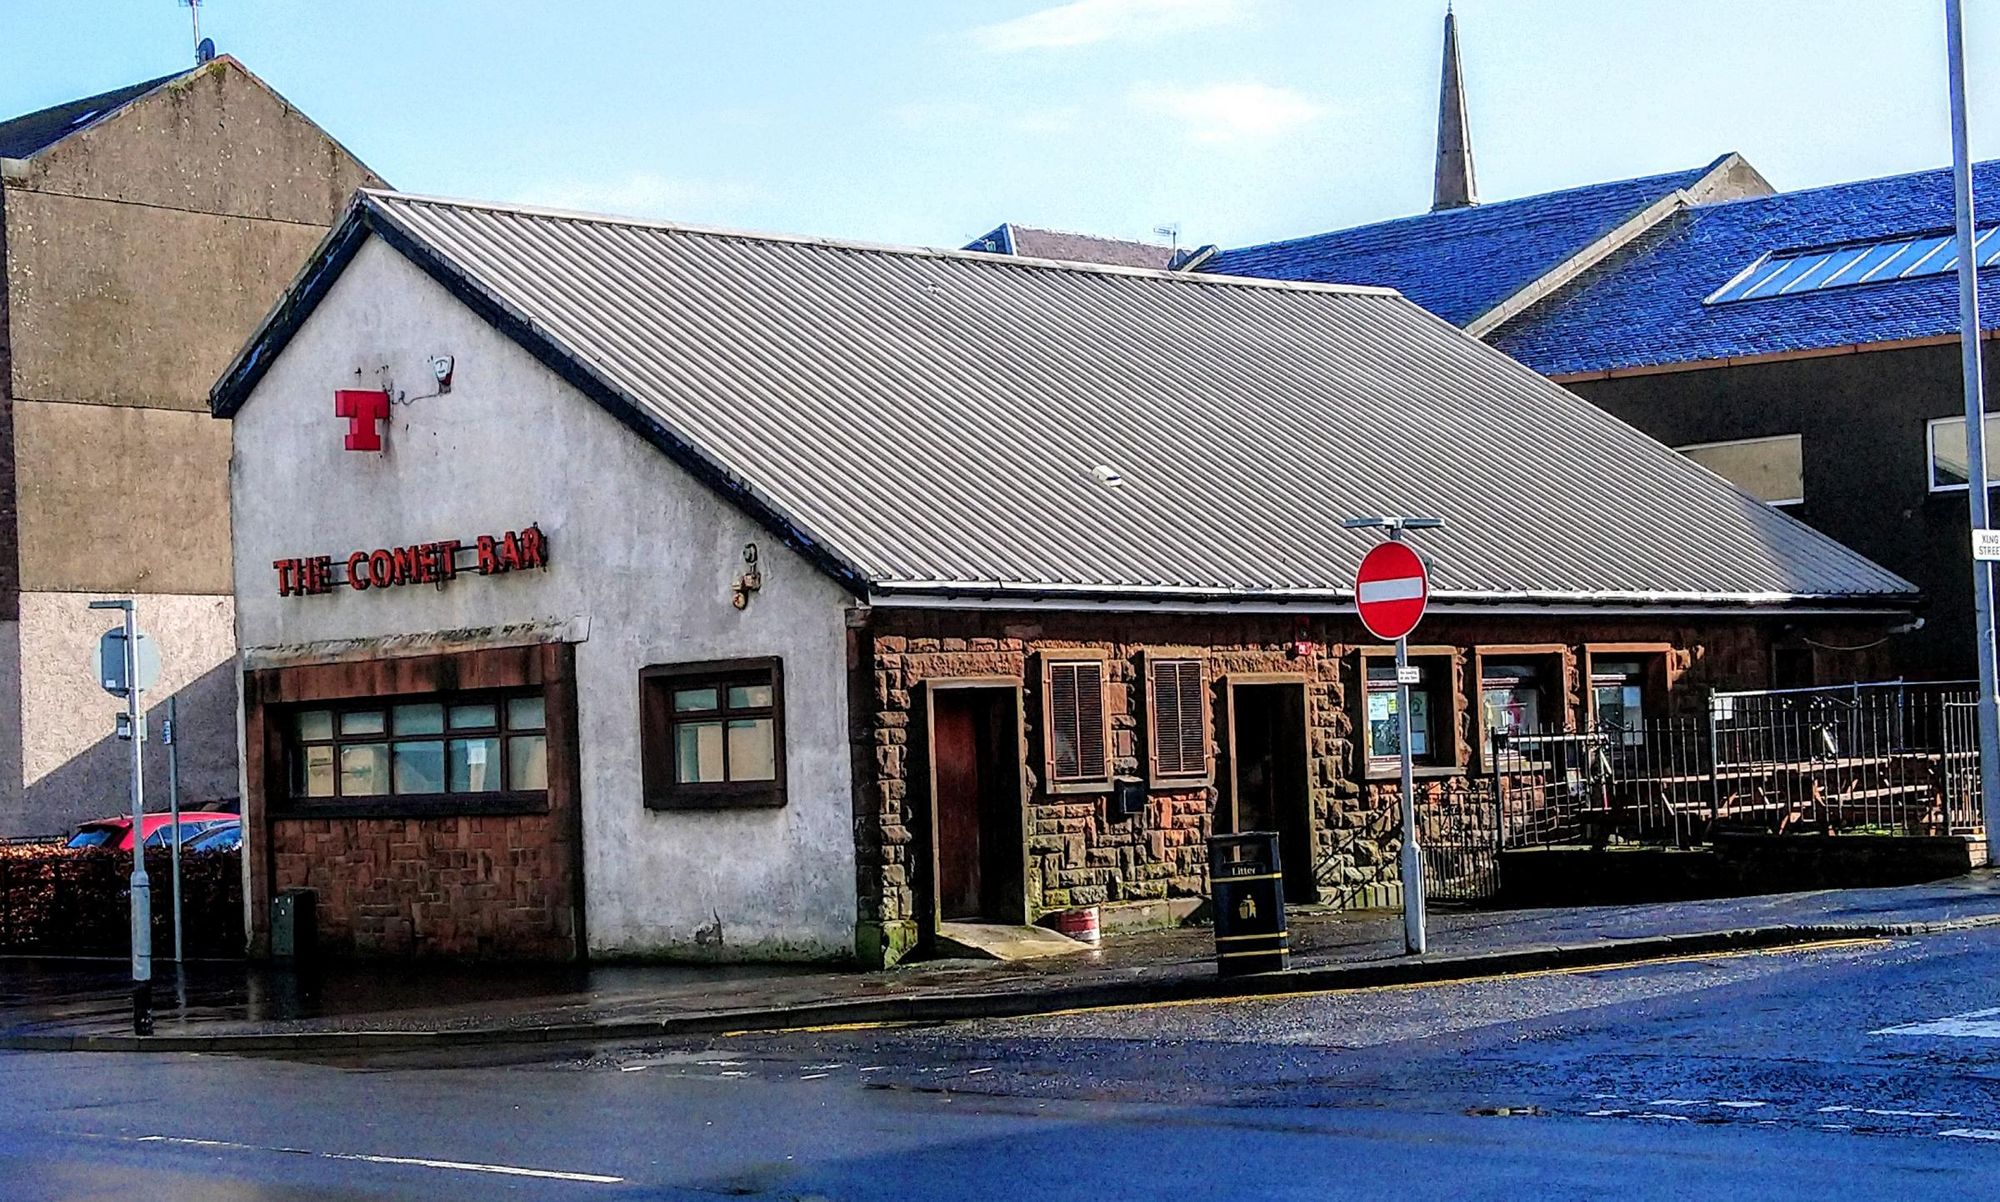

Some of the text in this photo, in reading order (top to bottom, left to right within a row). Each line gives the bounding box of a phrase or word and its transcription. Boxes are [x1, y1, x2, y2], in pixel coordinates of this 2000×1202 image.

[335, 390, 391, 451] T
[1981, 535, 1999, 544] KING
[1978, 545, 2000, 555] STREE
[273, 528, 547, 597] THE COMET BAR
[1231, 866, 1256, 876] Litter
